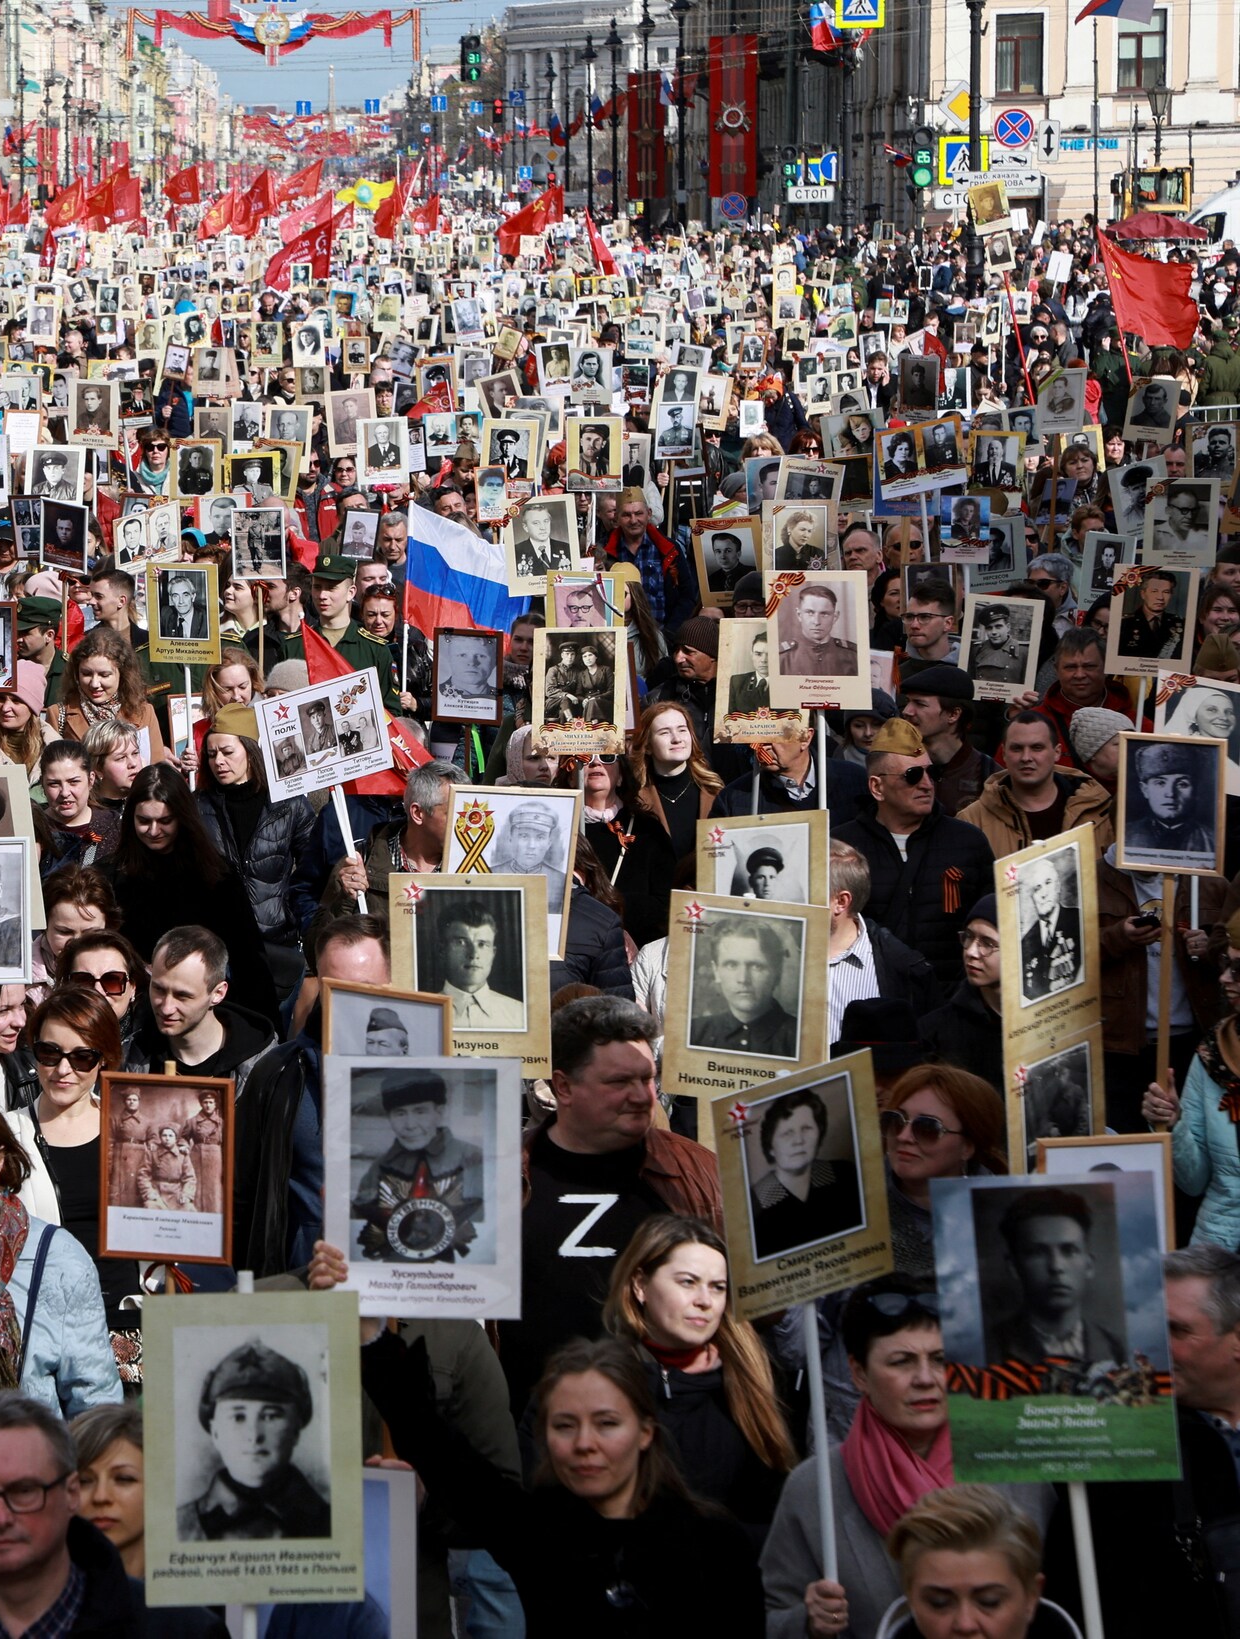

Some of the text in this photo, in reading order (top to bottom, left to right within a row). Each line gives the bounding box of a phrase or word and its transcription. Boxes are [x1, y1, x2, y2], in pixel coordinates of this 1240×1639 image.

[469, 53, 480, 64] 31
[917, 151, 931, 163] 26
[784, 164, 796, 175] 31
[795, 188, 827, 200] СТОП
[943, 193, 970, 205] СТО
[155, 648, 175, 656] Артур
[274, 724, 297, 736] ПОЛК
[317, 766, 334, 775] Попов
[284, 776, 303, 786] Булаев
[707, 1060, 776, 1080] Вишняков
[678, 1072, 736, 1090] Николай
[557, 1193, 620, 1258] Z
[776, 1242, 847, 1271] Смирнова
[391, 1269, 455, 1281] Хуснутдинов
[737, 1267, 812, 1298] Валентина
[813, 1241, 888, 1276] Яковлевна
[169, 1549, 341, 1566] Ефимчук Кирилл Иванович
[153, 1566, 203, 1580] рядовой,
[206, 1565, 241, 1578] погиб
[244, 1564, 299, 1577] 14.03.1945
[312, 1563, 357, 1575] Польше
[336, 1585, 358, 1596] полк
